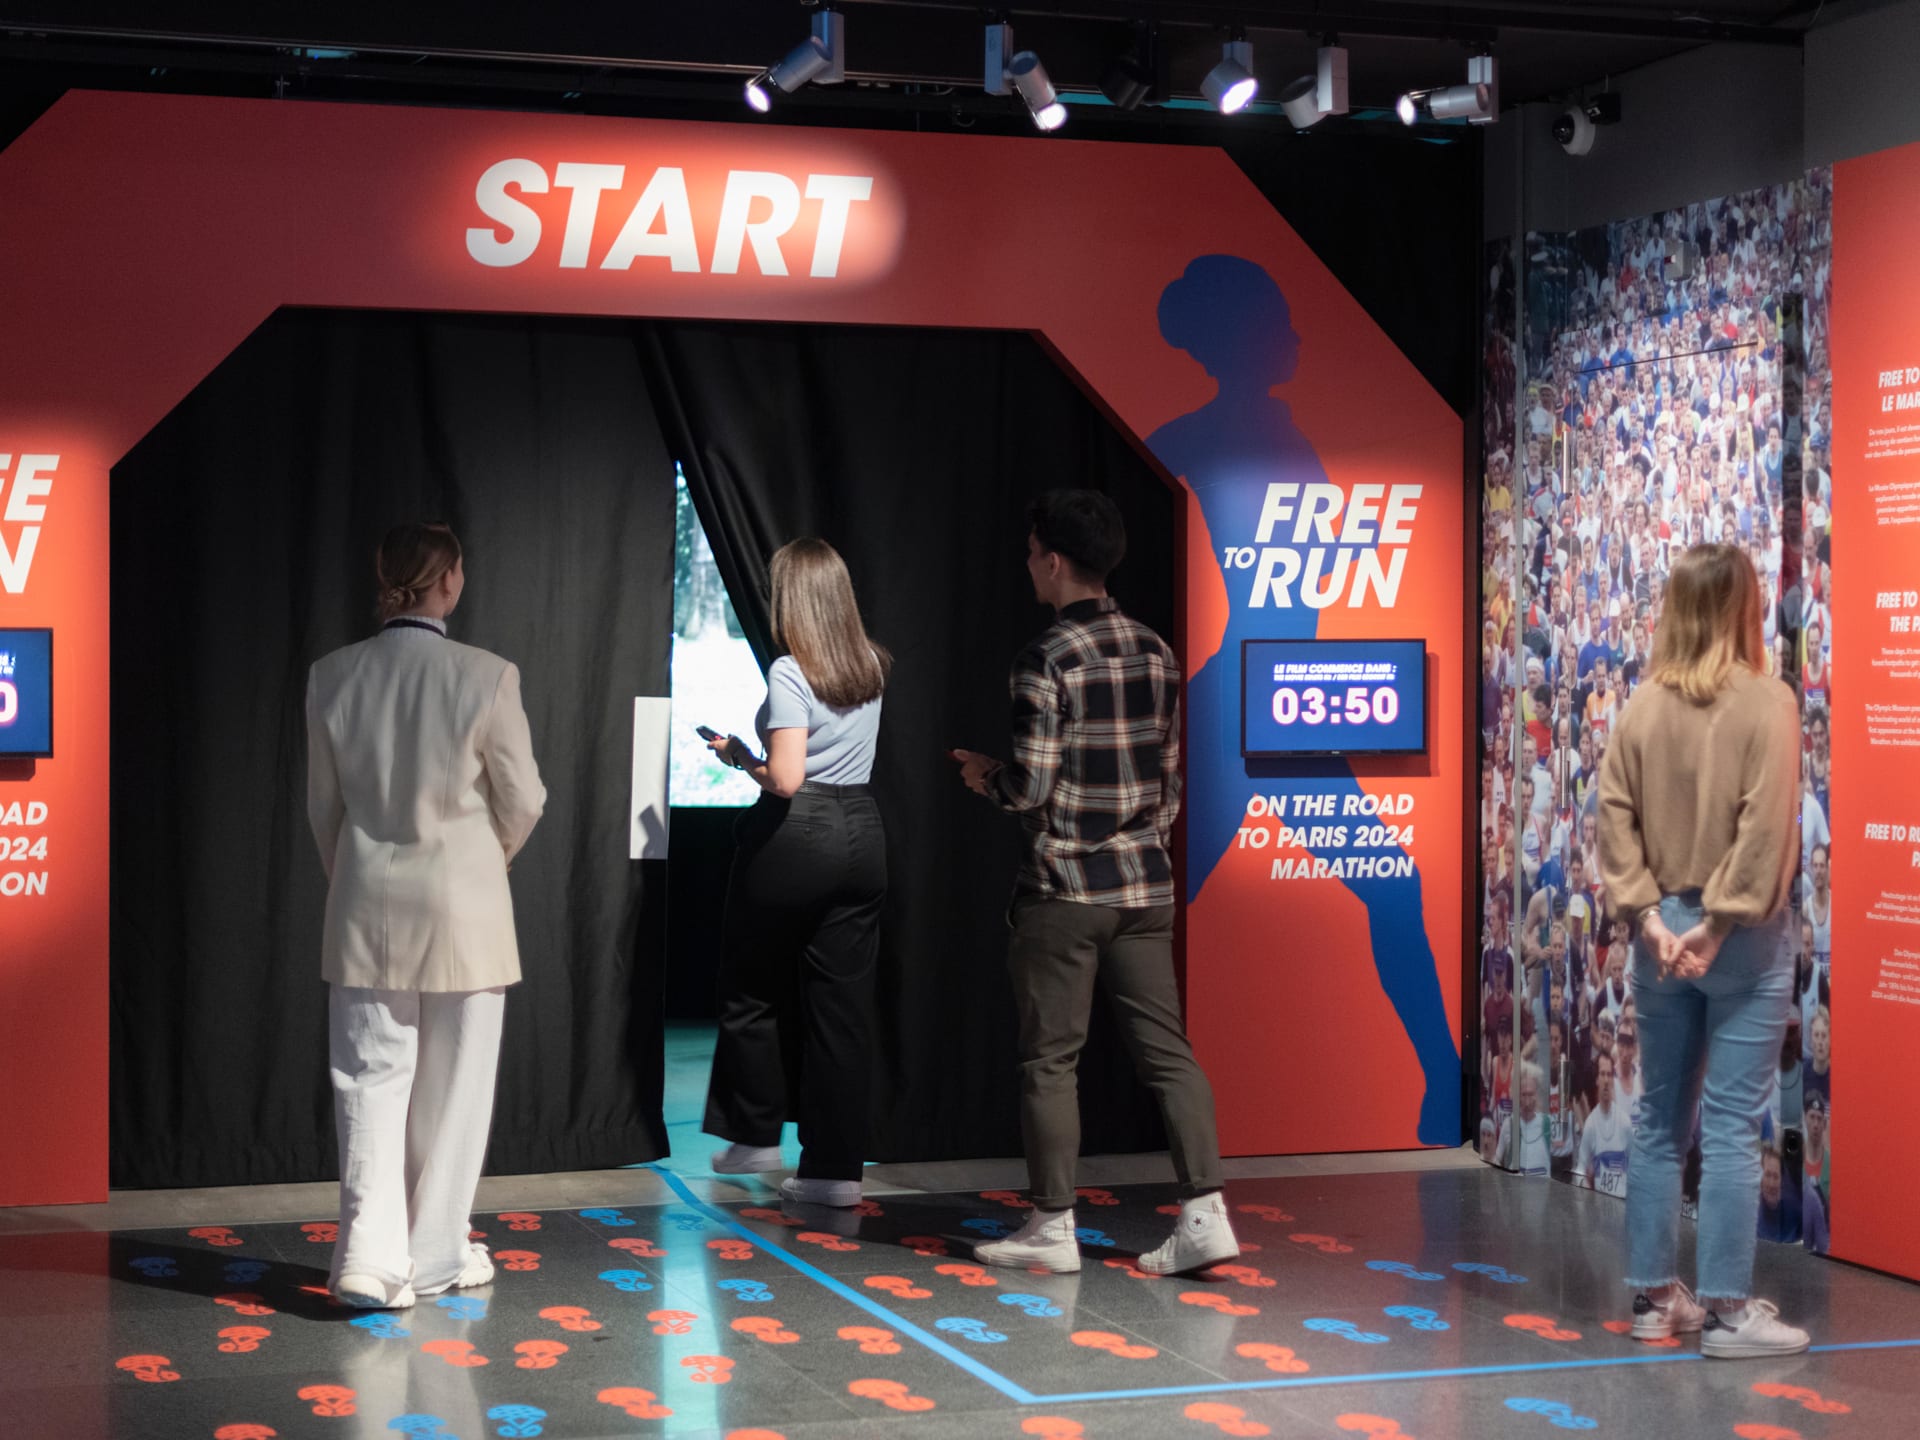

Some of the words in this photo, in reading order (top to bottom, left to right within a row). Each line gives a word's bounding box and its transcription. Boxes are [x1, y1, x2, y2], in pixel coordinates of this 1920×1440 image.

[466, 158, 873, 278] START
[1879, 369, 1903, 388] FREE
[1905, 367, 1919, 384] TO
[1882, 395, 1894, 412] LE
[1254, 483, 1424, 543] FREE
[1224, 547, 1256, 569] TO
[1248, 547, 1408, 608] RUN
[1876, 591, 1901, 609] FREE
[1903, 591, 1918, 608] TO
[1890, 616, 1911, 632] THE
[1273, 687, 1398, 725] 03:50
[0, 801, 48, 826] AD
[1247, 795, 1287, 817] ON
[1293, 794, 1337, 817] THE
[1342, 794, 1414, 816] ROAD
[1238, 827, 1270, 849] TO
[1277, 825, 1348, 848] PARIS
[1353, 825, 1414, 847] 2024
[1864, 823, 1890, 840] FREE
[1892, 824, 1906, 842] TO
[1271, 856, 1414, 880] MARATHON
